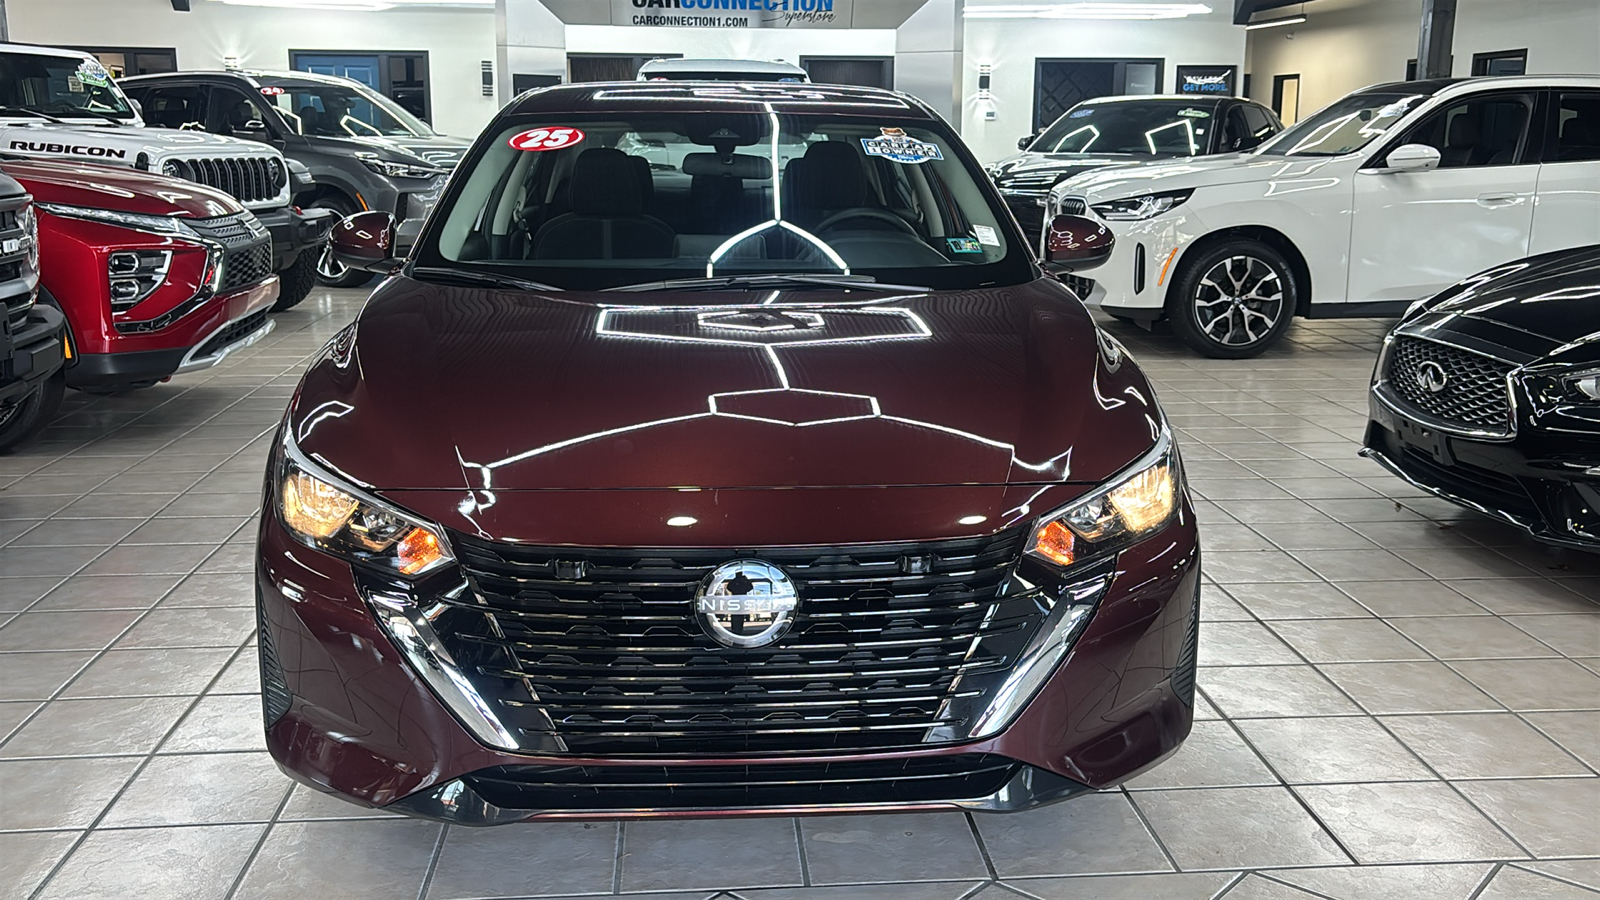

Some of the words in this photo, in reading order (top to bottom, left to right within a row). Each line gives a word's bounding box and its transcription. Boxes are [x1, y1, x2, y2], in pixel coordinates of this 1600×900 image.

[632, 15, 748, 27] CARCONNECTION1.COM
[1182, 83, 1199, 92] GET
[519, 129, 574, 148] 25
[9, 140, 126, 159] RUBICON
[701, 598, 793, 612] NISSA
